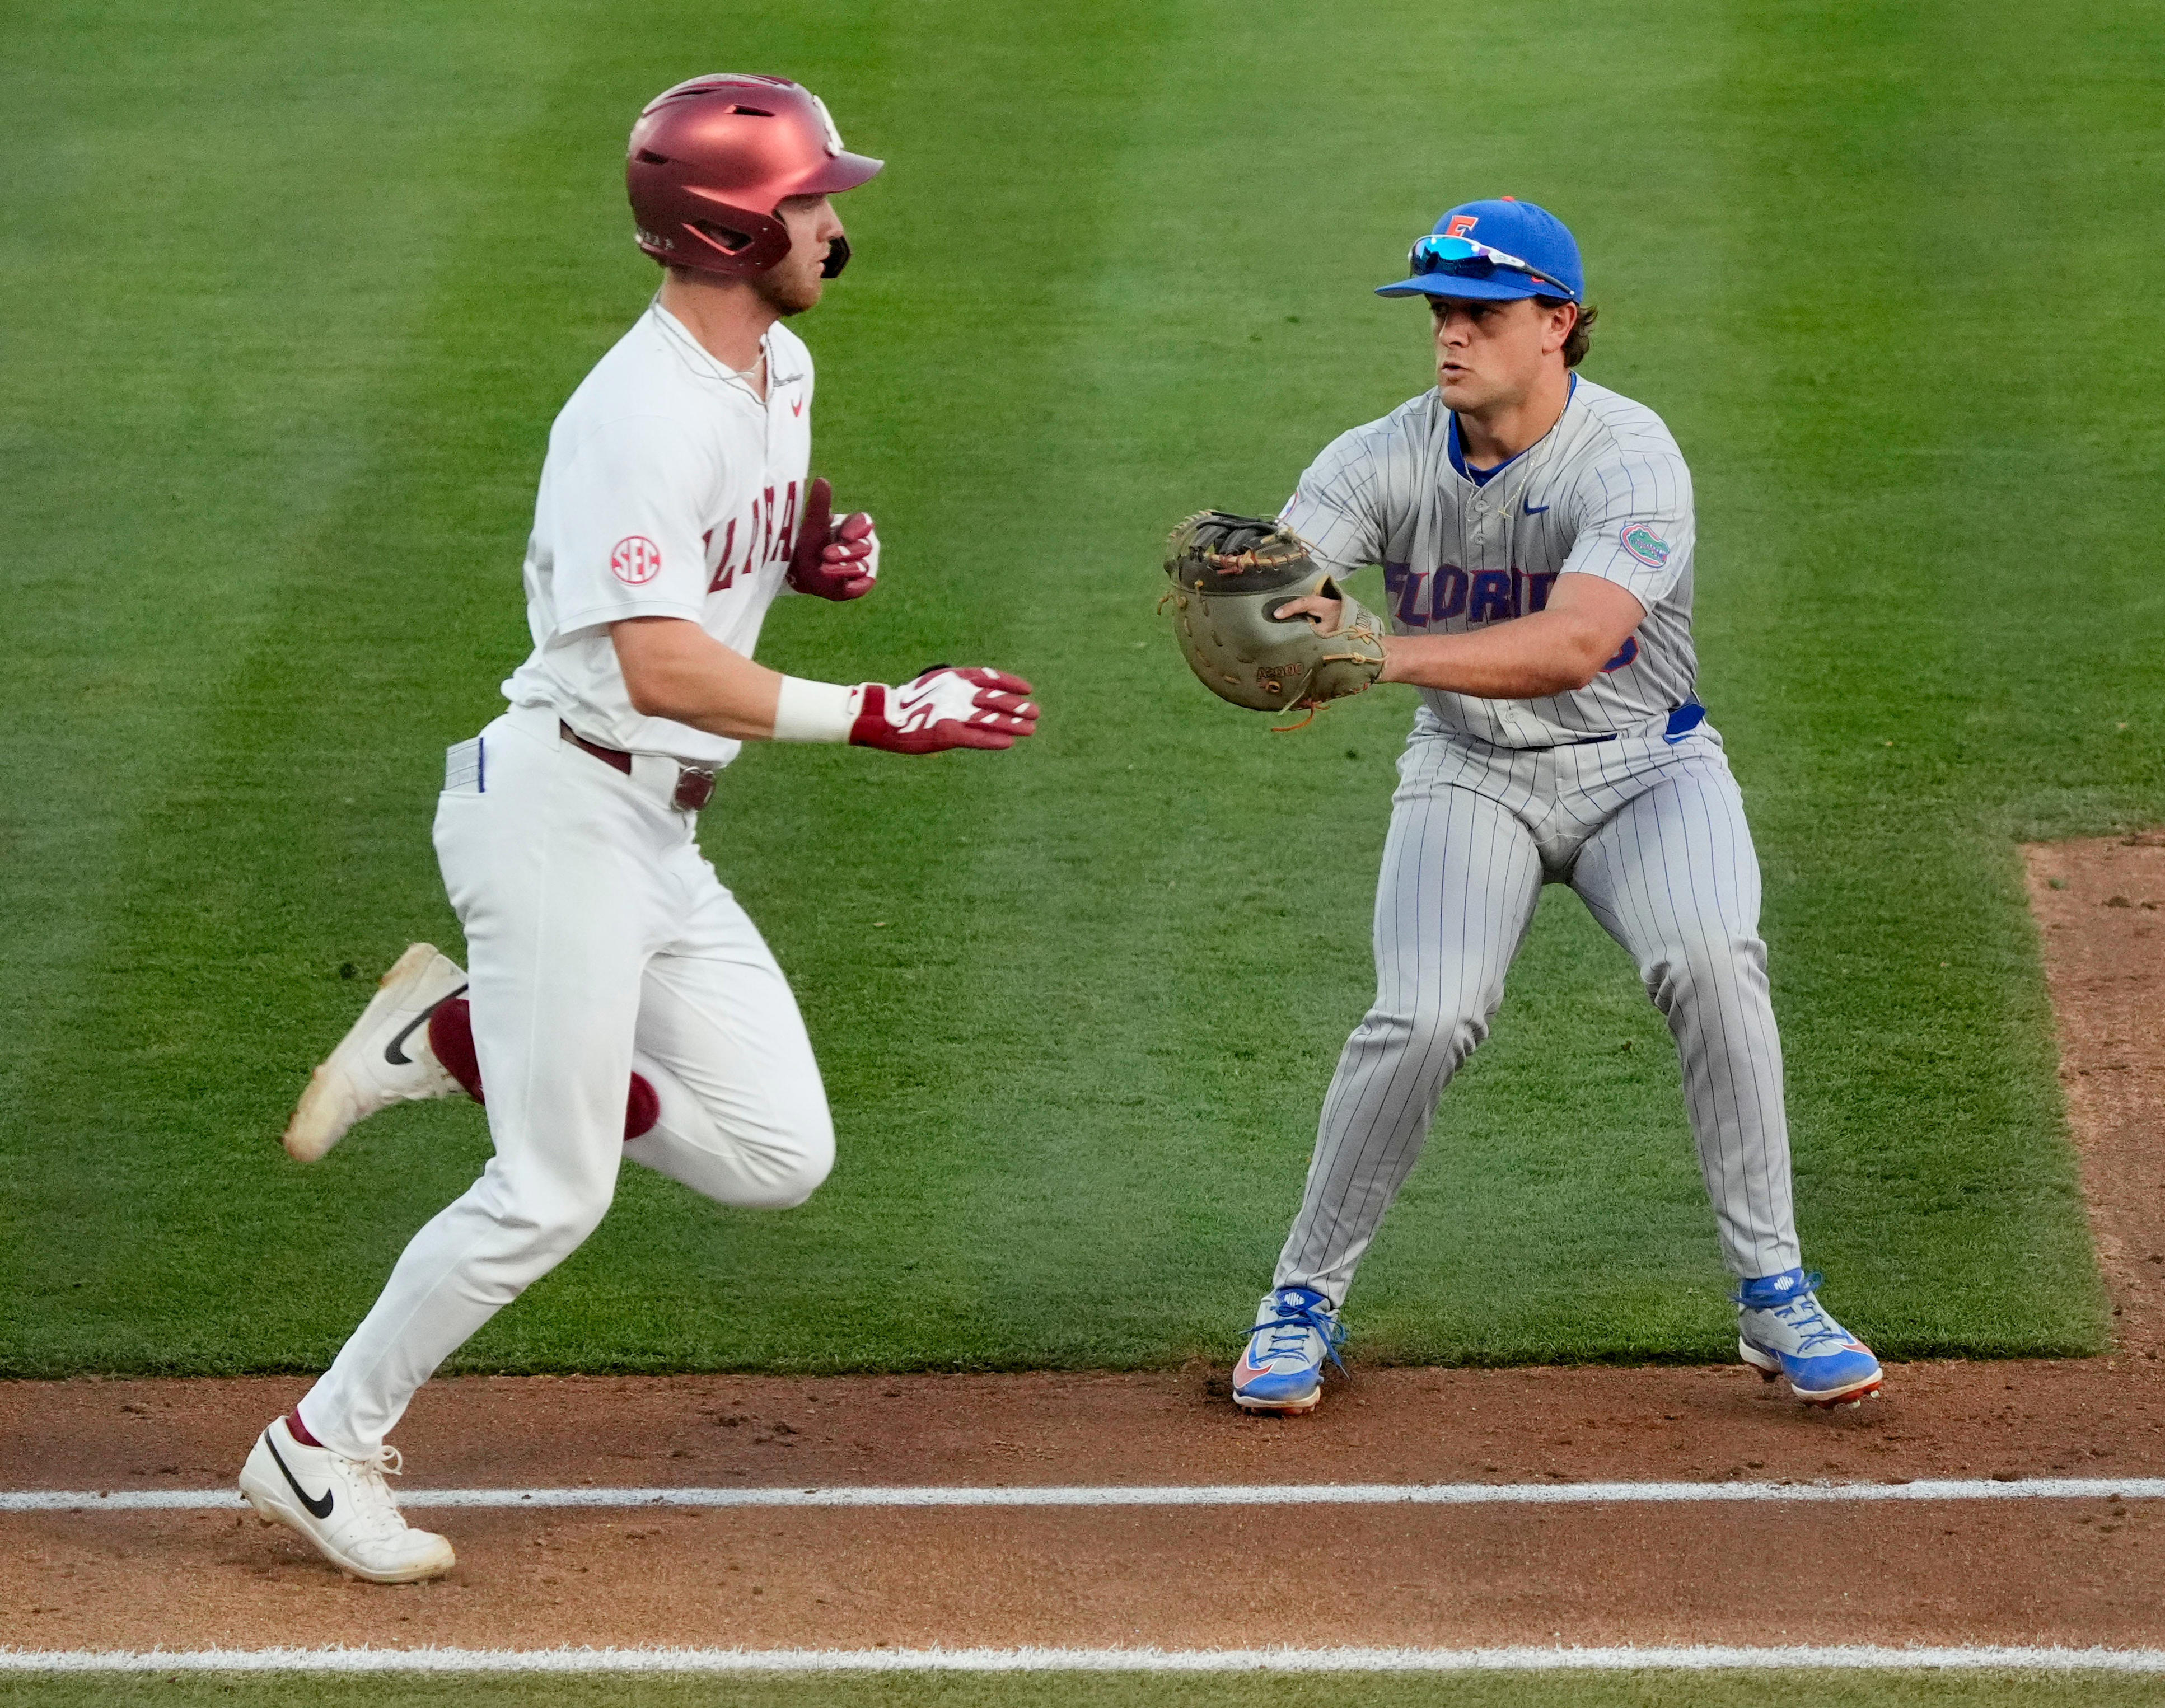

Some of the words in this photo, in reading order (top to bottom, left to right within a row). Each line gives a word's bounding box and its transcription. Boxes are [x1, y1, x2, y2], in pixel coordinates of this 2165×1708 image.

[1445, 215, 1479, 237] F
[612, 537, 660, 582] SEC
[1384, 561, 1558, 628] FLORID
[1284, 1292, 1304, 1307] NIKE
